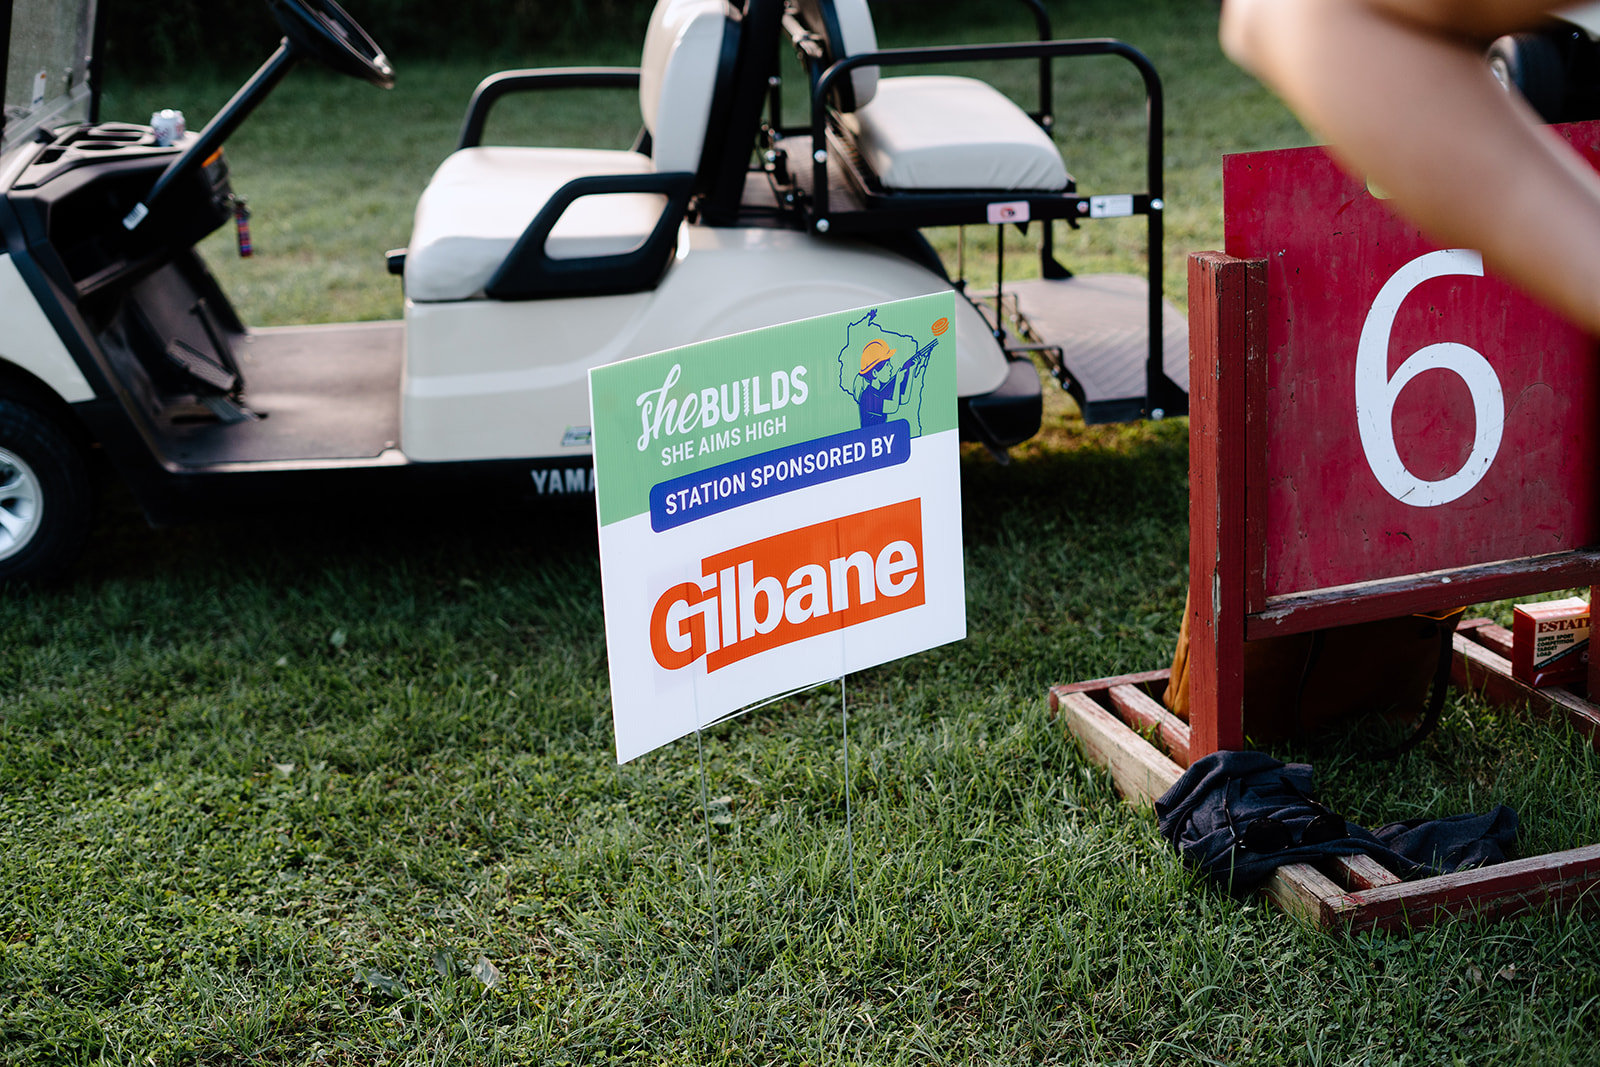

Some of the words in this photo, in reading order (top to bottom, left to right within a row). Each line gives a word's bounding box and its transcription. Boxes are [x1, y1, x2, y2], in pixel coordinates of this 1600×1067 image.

[1355, 248, 1505, 507] 6
[661, 440, 695, 466] SHE
[698, 427, 741, 456] AIMS
[745, 415, 787, 443] HIGH
[665, 472, 746, 515] STATION
[750, 441, 866, 489] SPONSORED
[871, 434, 895, 458] BY
[650, 540, 919, 670] Gilbane
